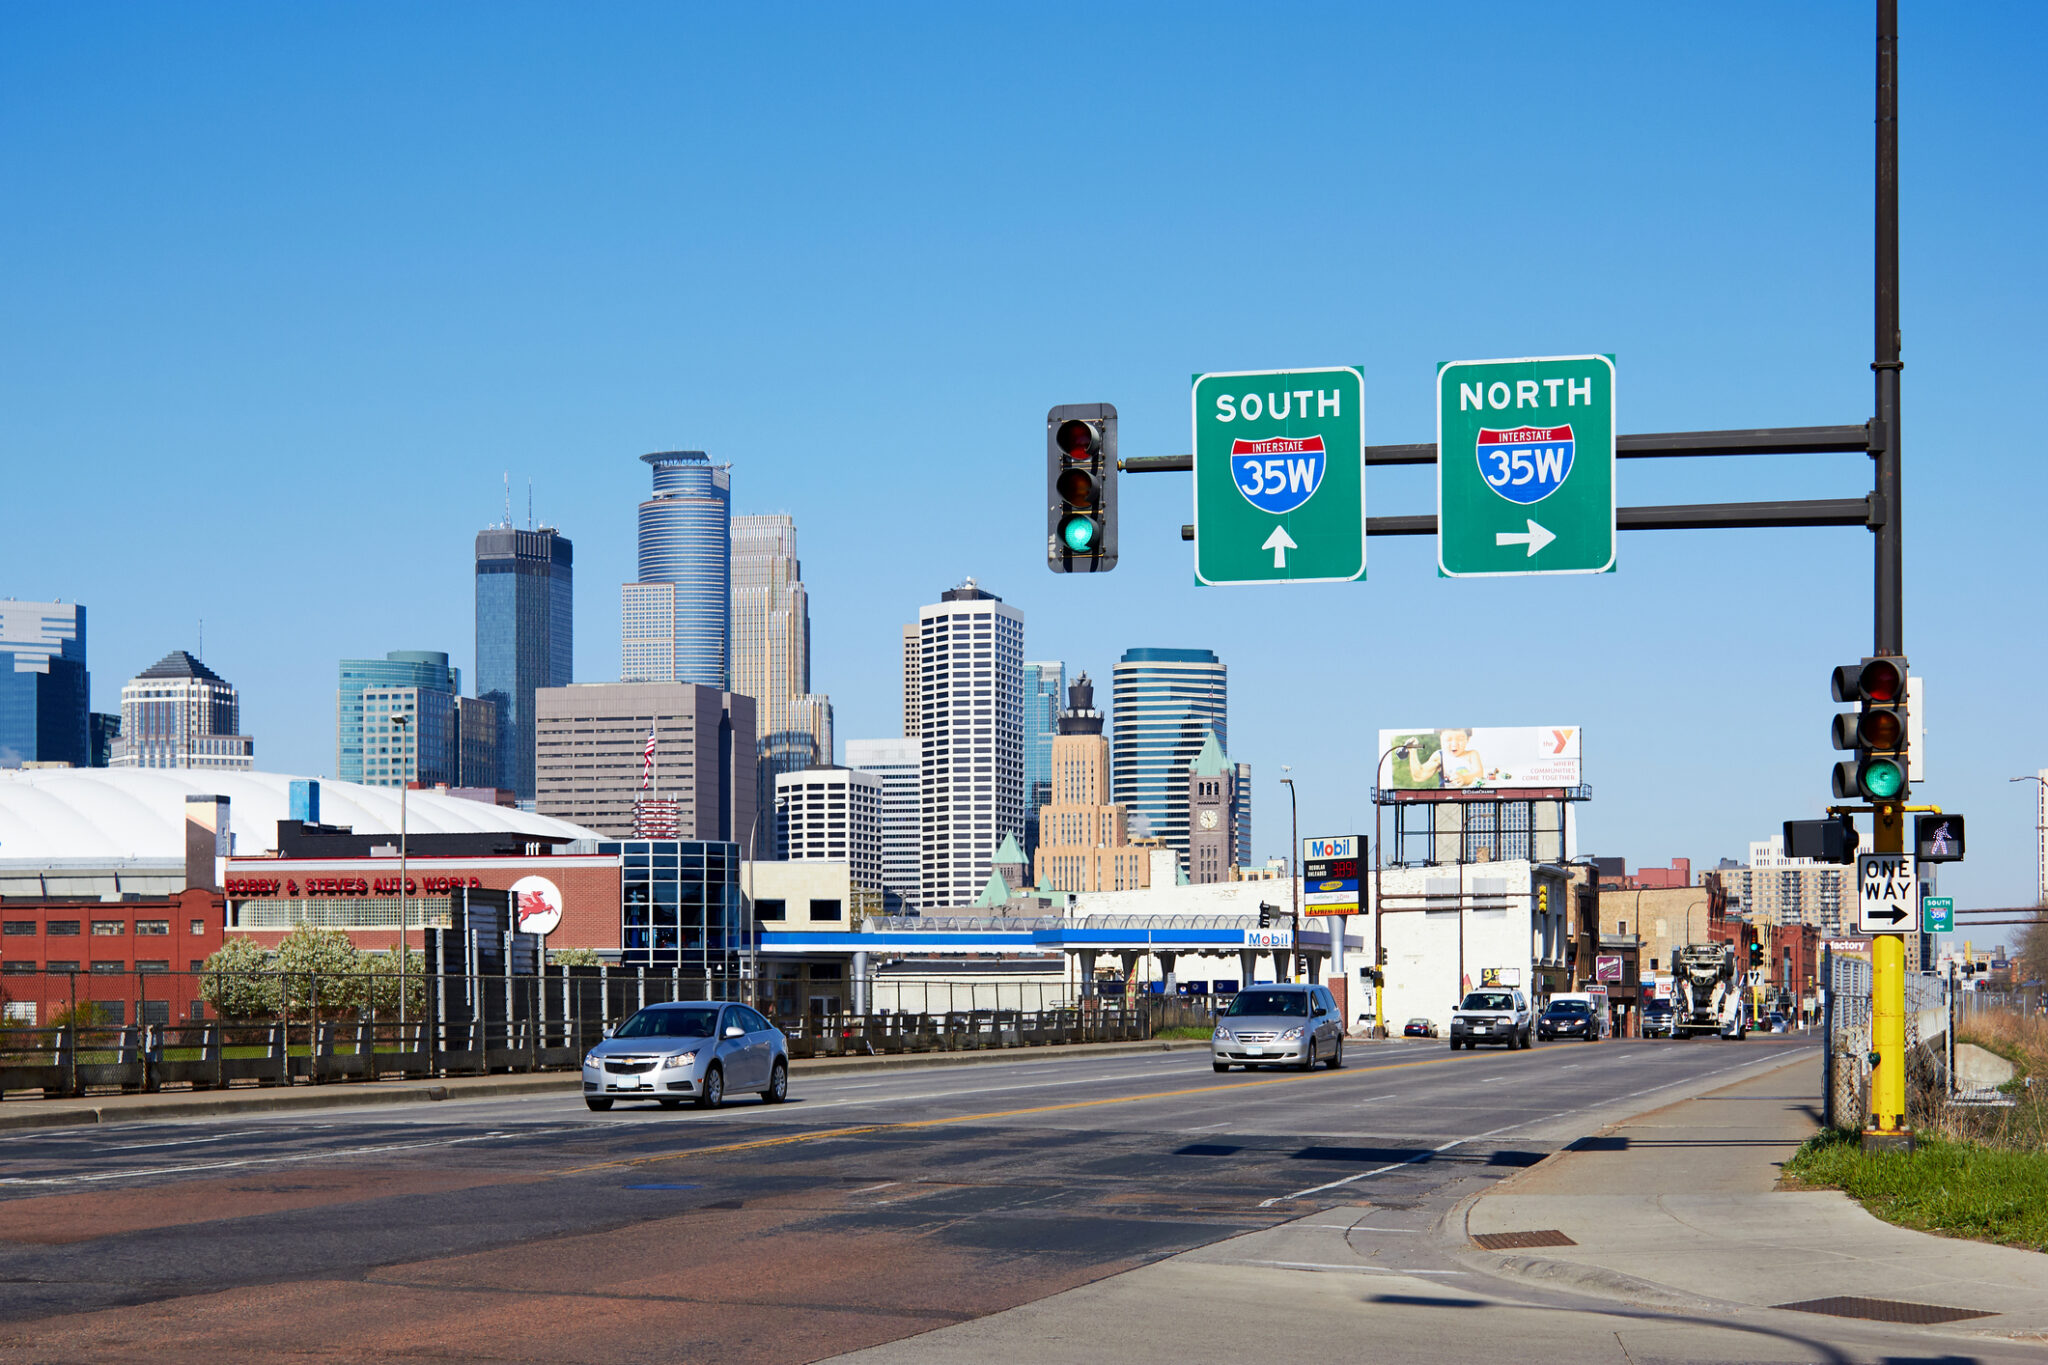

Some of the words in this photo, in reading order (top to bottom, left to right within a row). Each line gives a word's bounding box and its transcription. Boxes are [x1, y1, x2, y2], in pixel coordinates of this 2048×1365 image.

[1460, 377, 1592, 412] NORTH
[1215, 389, 1340, 423] SOUTH
[1498, 430, 1552, 443] INTERSTATE
[1251, 440, 1304, 454] INTERSTATE
[1487, 447, 1565, 487] 35W
[1241, 458, 1316, 496] 35W
[1312, 839, 1350, 857] Mobil
[1866, 860, 1910, 878] ONE
[225, 879, 279, 893] BOBBY
[286, 879, 298, 892] &
[305, 878, 367, 892] STEVE'S
[373, 877, 416, 891] AUTO
[1865, 882, 1911, 900] WAY
[1249, 933, 1288, 945] Mobil
[1830, 940, 1865, 951] factory
